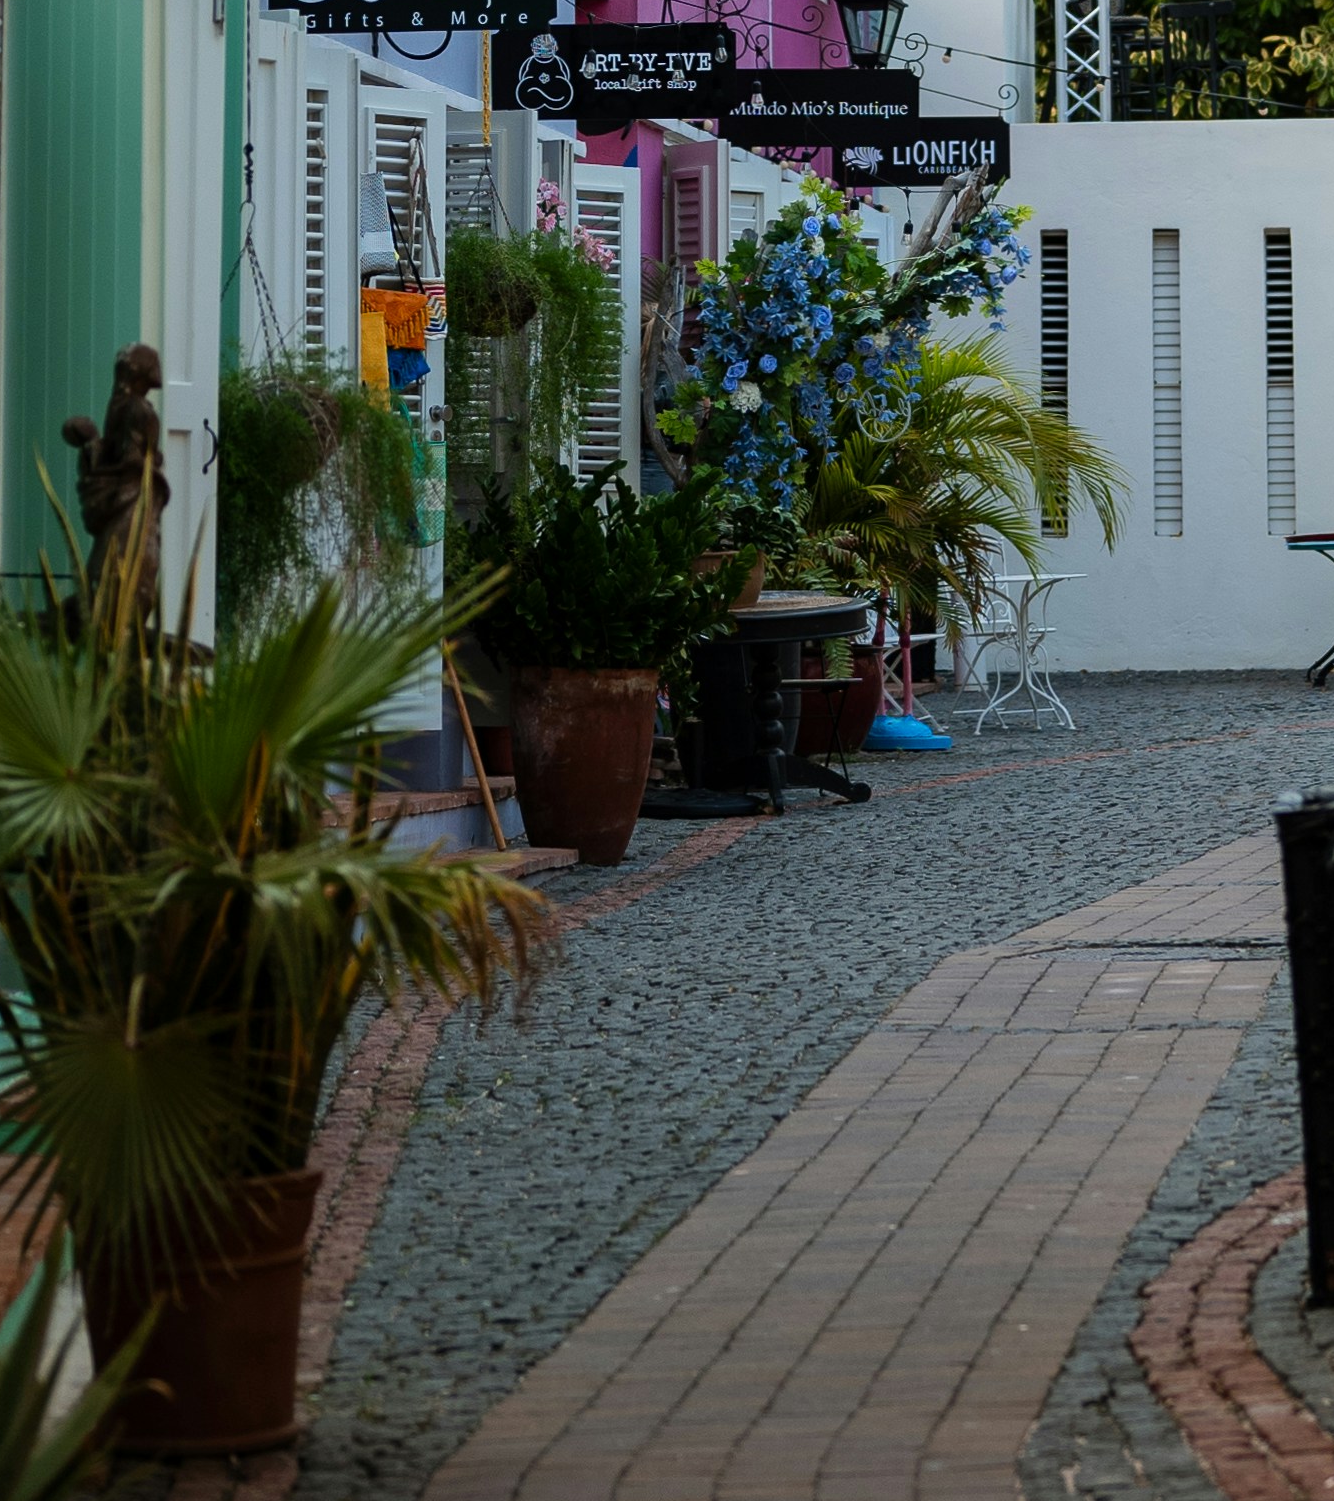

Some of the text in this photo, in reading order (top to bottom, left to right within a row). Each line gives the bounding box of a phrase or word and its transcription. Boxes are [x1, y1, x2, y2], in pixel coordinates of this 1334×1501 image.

[304, 10, 528, 29] Gifts & More
[594, 79, 628, 90] local
[667, 80, 697, 92] shop
[729, 100, 788, 116] Mundo
[838, 100, 909, 119] Boutique
[918, 165, 972, 175] CARIBBEAN
